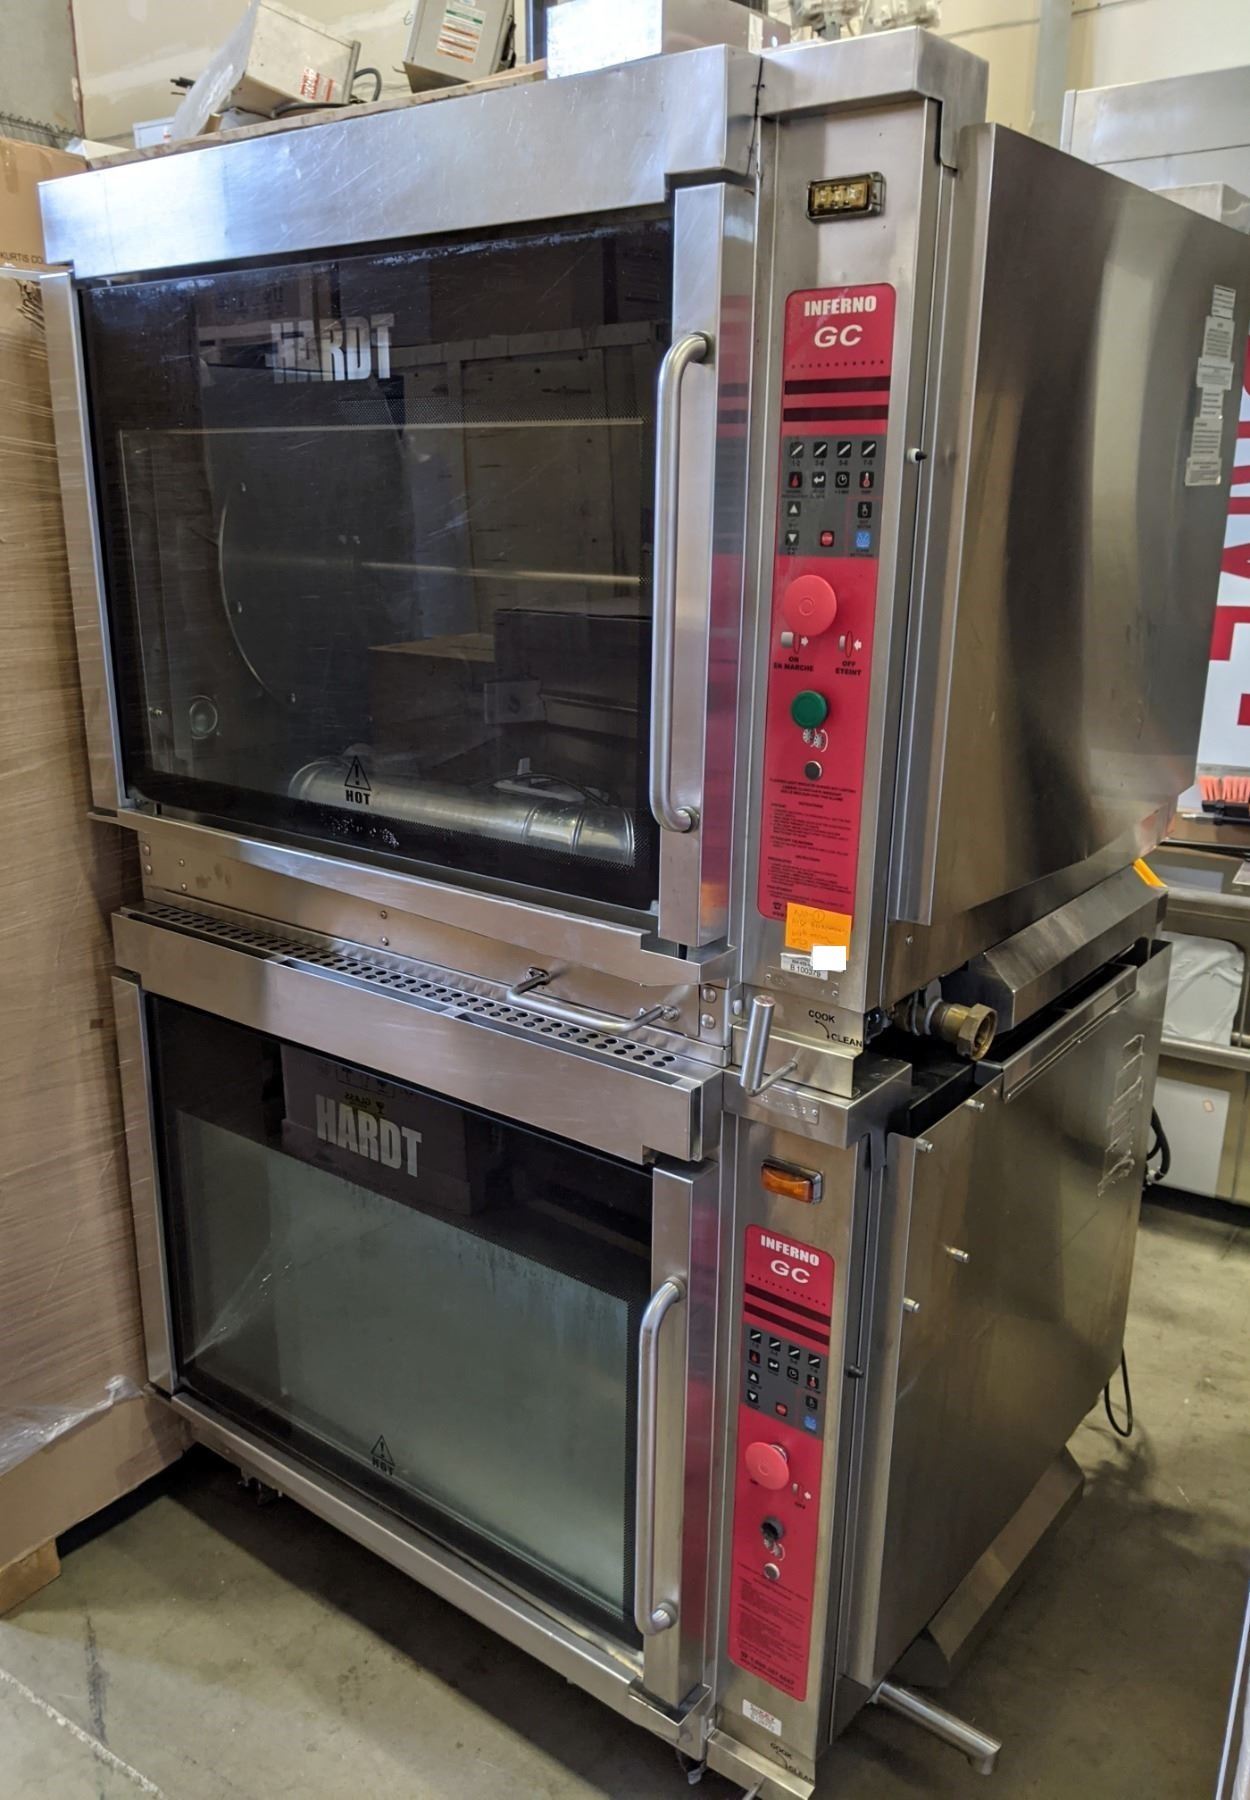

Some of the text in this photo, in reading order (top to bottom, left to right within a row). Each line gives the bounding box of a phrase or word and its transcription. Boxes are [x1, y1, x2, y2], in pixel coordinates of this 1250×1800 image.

[803, 295, 877, 316] INFERNO
[814, 324, 863, 348] GC
[271, 313, 394, 384] HARDT
[773, 662, 815, 672] EN MARCHE
[835, 667, 862, 676] ETEINT
[842, 660, 857, 668] OFF
[345, 789, 371, 806] HOT
[808, 1009, 836, 1024] COOK
[831, 1033, 863, 1048] CLEAN
[315, 1093, 422, 1178] HARDT
[760, 1234, 820, 1267] INFERNO
[770, 1259, 810, 1284] GC
